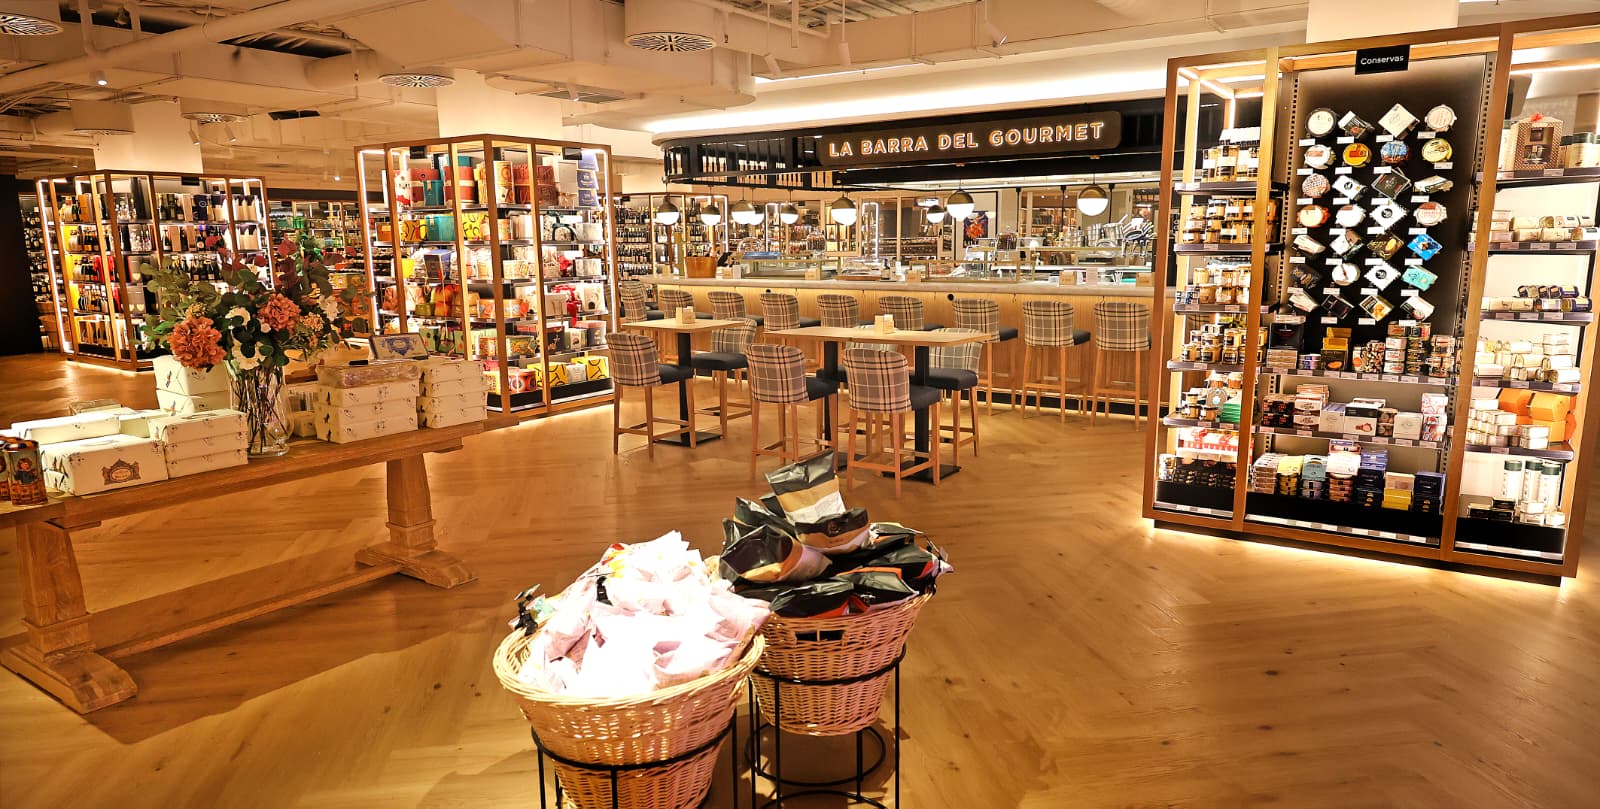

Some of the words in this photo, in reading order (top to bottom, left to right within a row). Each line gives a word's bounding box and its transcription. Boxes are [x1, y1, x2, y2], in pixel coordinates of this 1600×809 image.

[1360, 55, 1404, 65] Conservas
[828, 141, 853, 158] LA
[860, 135, 929, 155] BARRA
[938, 132, 979, 150] DEL
[988, 121, 1104, 147] GOURMET
